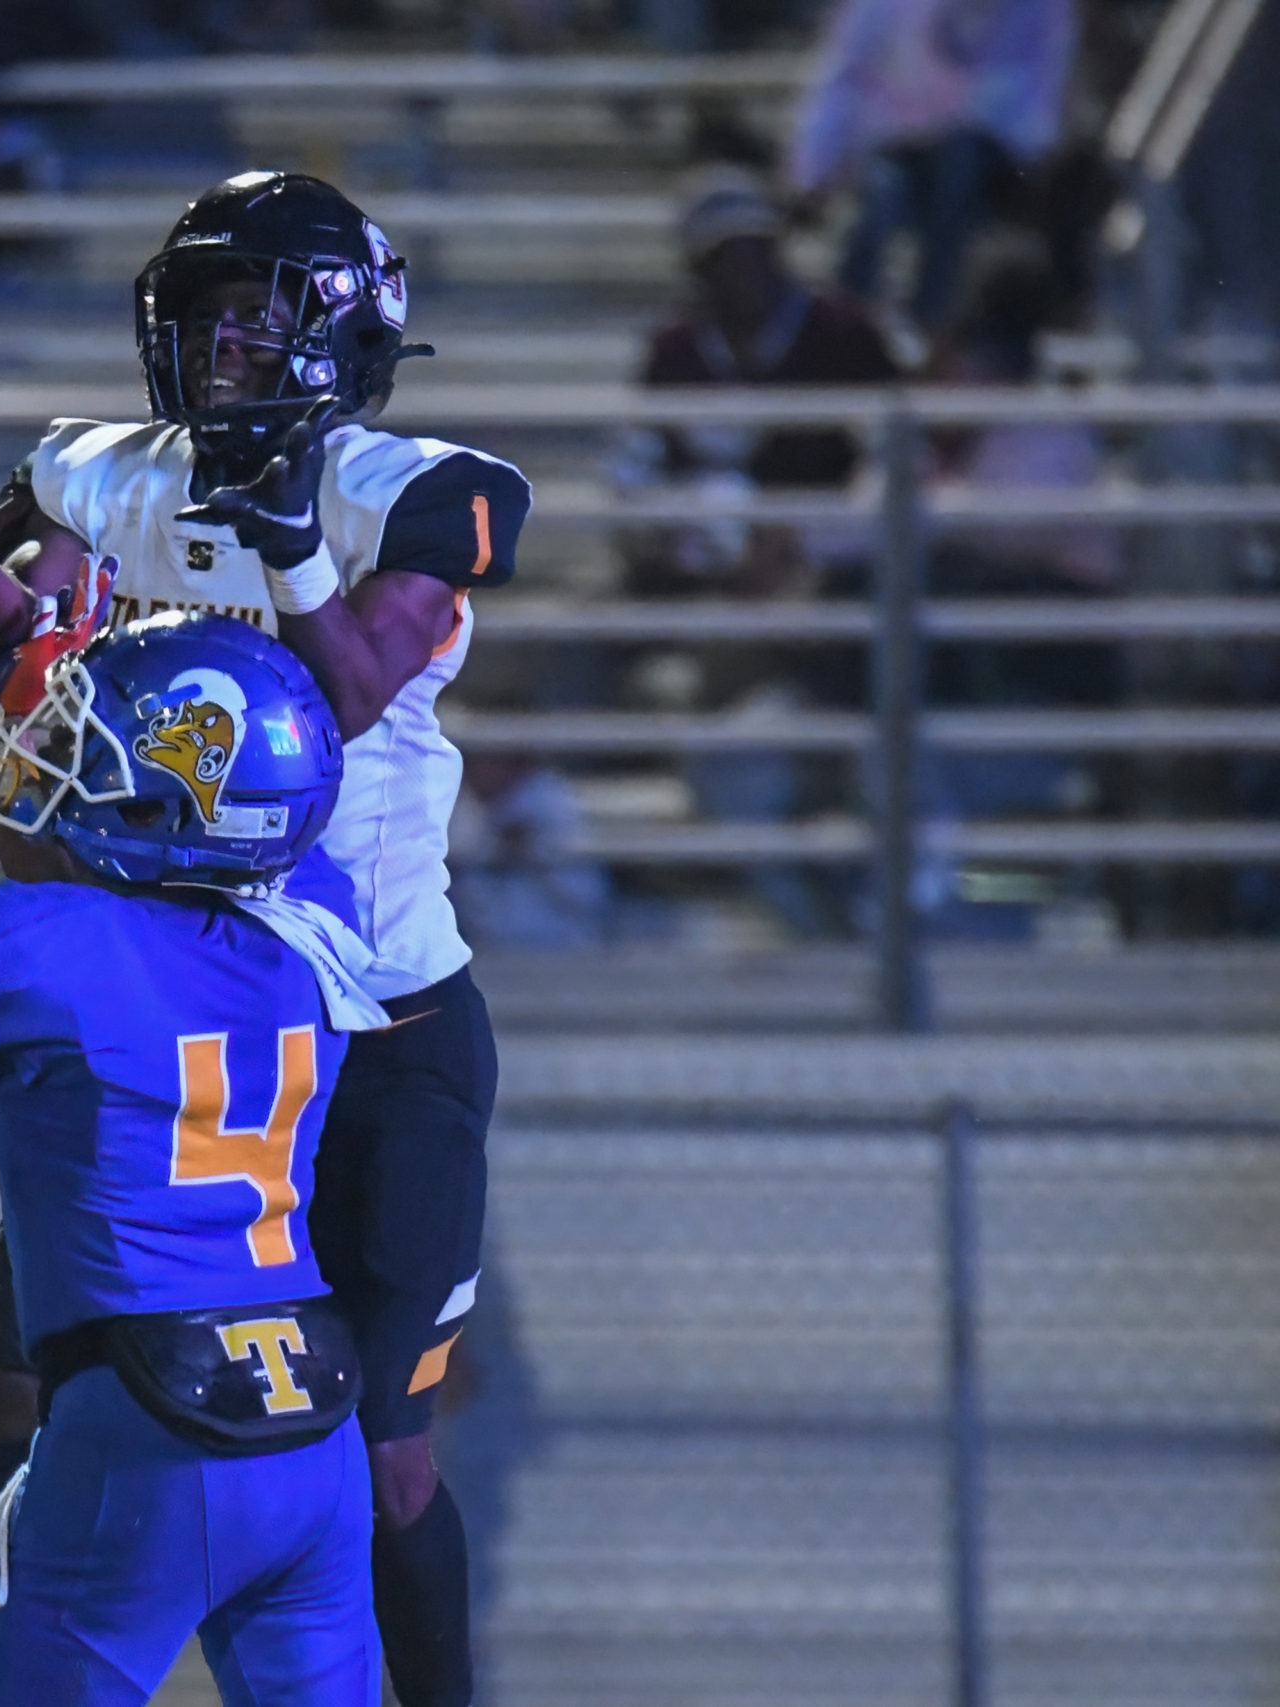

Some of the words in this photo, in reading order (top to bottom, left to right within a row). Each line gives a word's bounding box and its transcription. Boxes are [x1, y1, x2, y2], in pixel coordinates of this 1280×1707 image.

[471, 495, 492, 575] 1
[169, 1023, 318, 1268] 4
[215, 1317, 313, 1415] T
